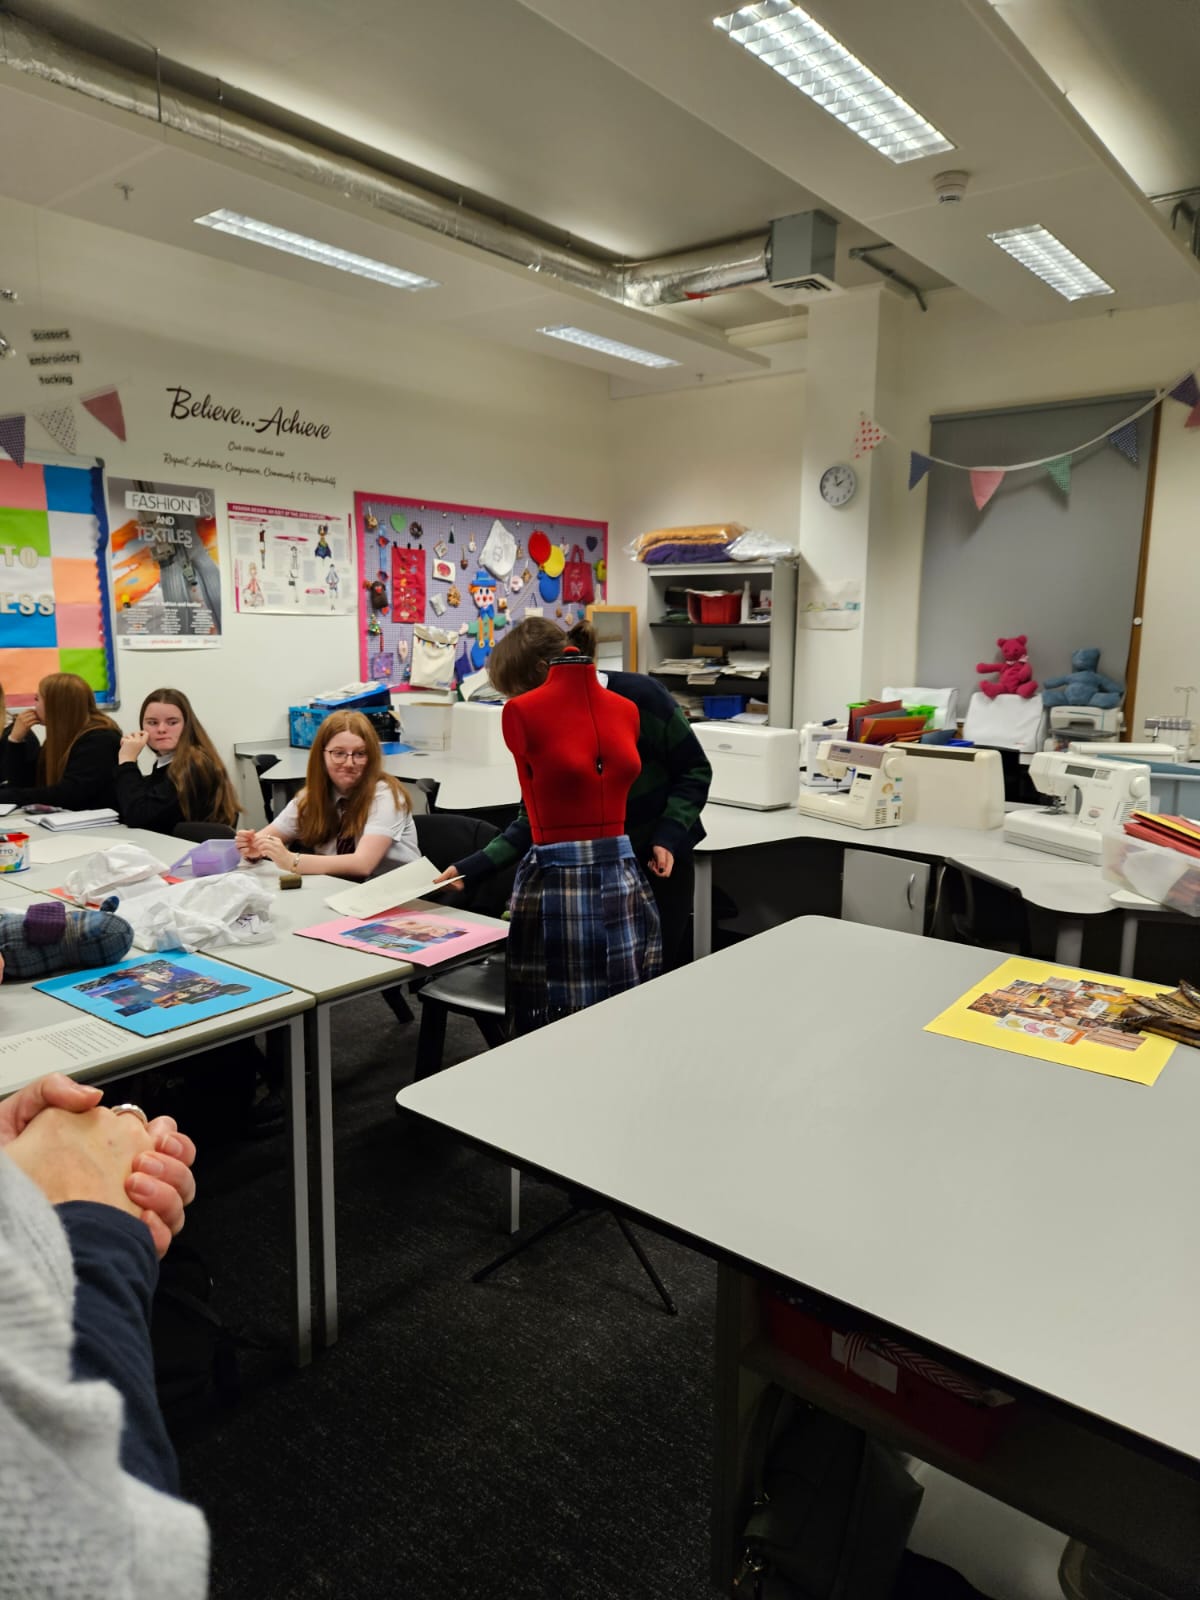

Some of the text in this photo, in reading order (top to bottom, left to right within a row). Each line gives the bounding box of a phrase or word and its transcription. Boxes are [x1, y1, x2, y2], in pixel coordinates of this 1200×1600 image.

[29, 353, 81, 366] embroidery
[228, 441, 242, 451] Our
[132, 493, 192, 512] FASHION
[156, 516, 175, 525] AND
[136, 526, 193, 548] TEXTILES
[0, 544, 39, 569] TO
